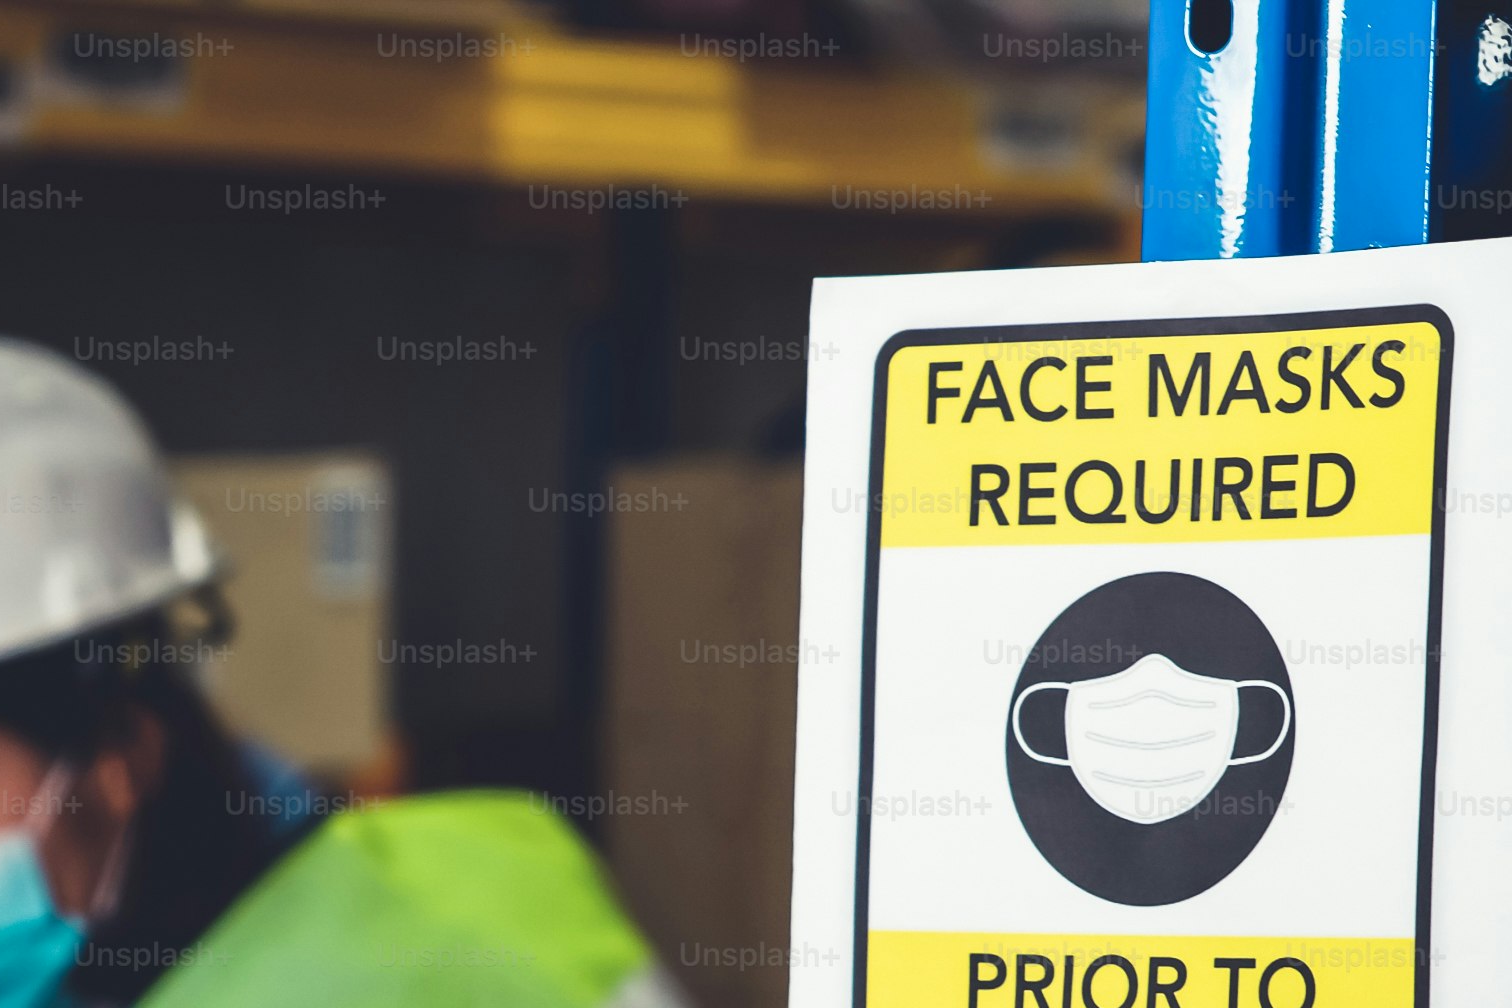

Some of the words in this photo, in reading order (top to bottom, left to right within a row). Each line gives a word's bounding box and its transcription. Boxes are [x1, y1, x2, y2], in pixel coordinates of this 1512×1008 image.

[926, 355, 1116, 425] FACE
[1148, 340, 1406, 418] MASKS
[969, 452, 1356, 527] REQUIRED
